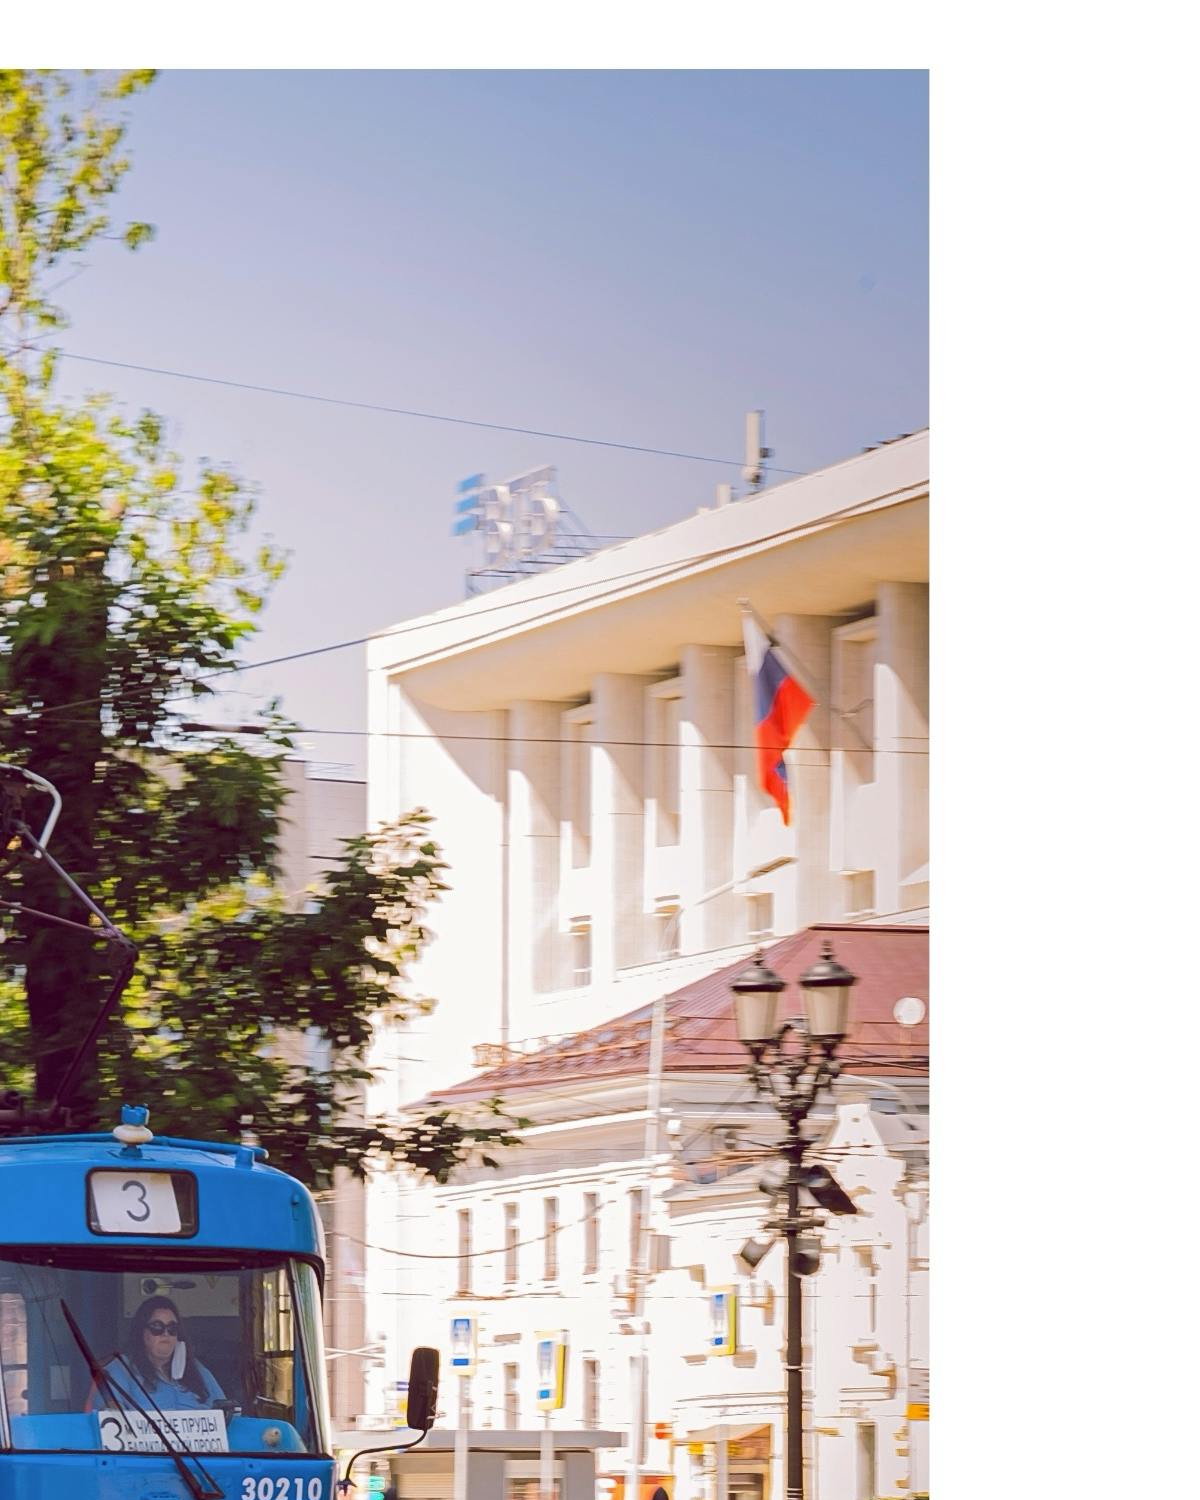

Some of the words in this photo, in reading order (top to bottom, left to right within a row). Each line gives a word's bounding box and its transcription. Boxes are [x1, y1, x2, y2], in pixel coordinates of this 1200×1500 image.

[122, 1180, 150, 1222] 3
[101, 1417, 125, 1451] 3
[181, 1416, 218, 1435] ПРУДЫ
